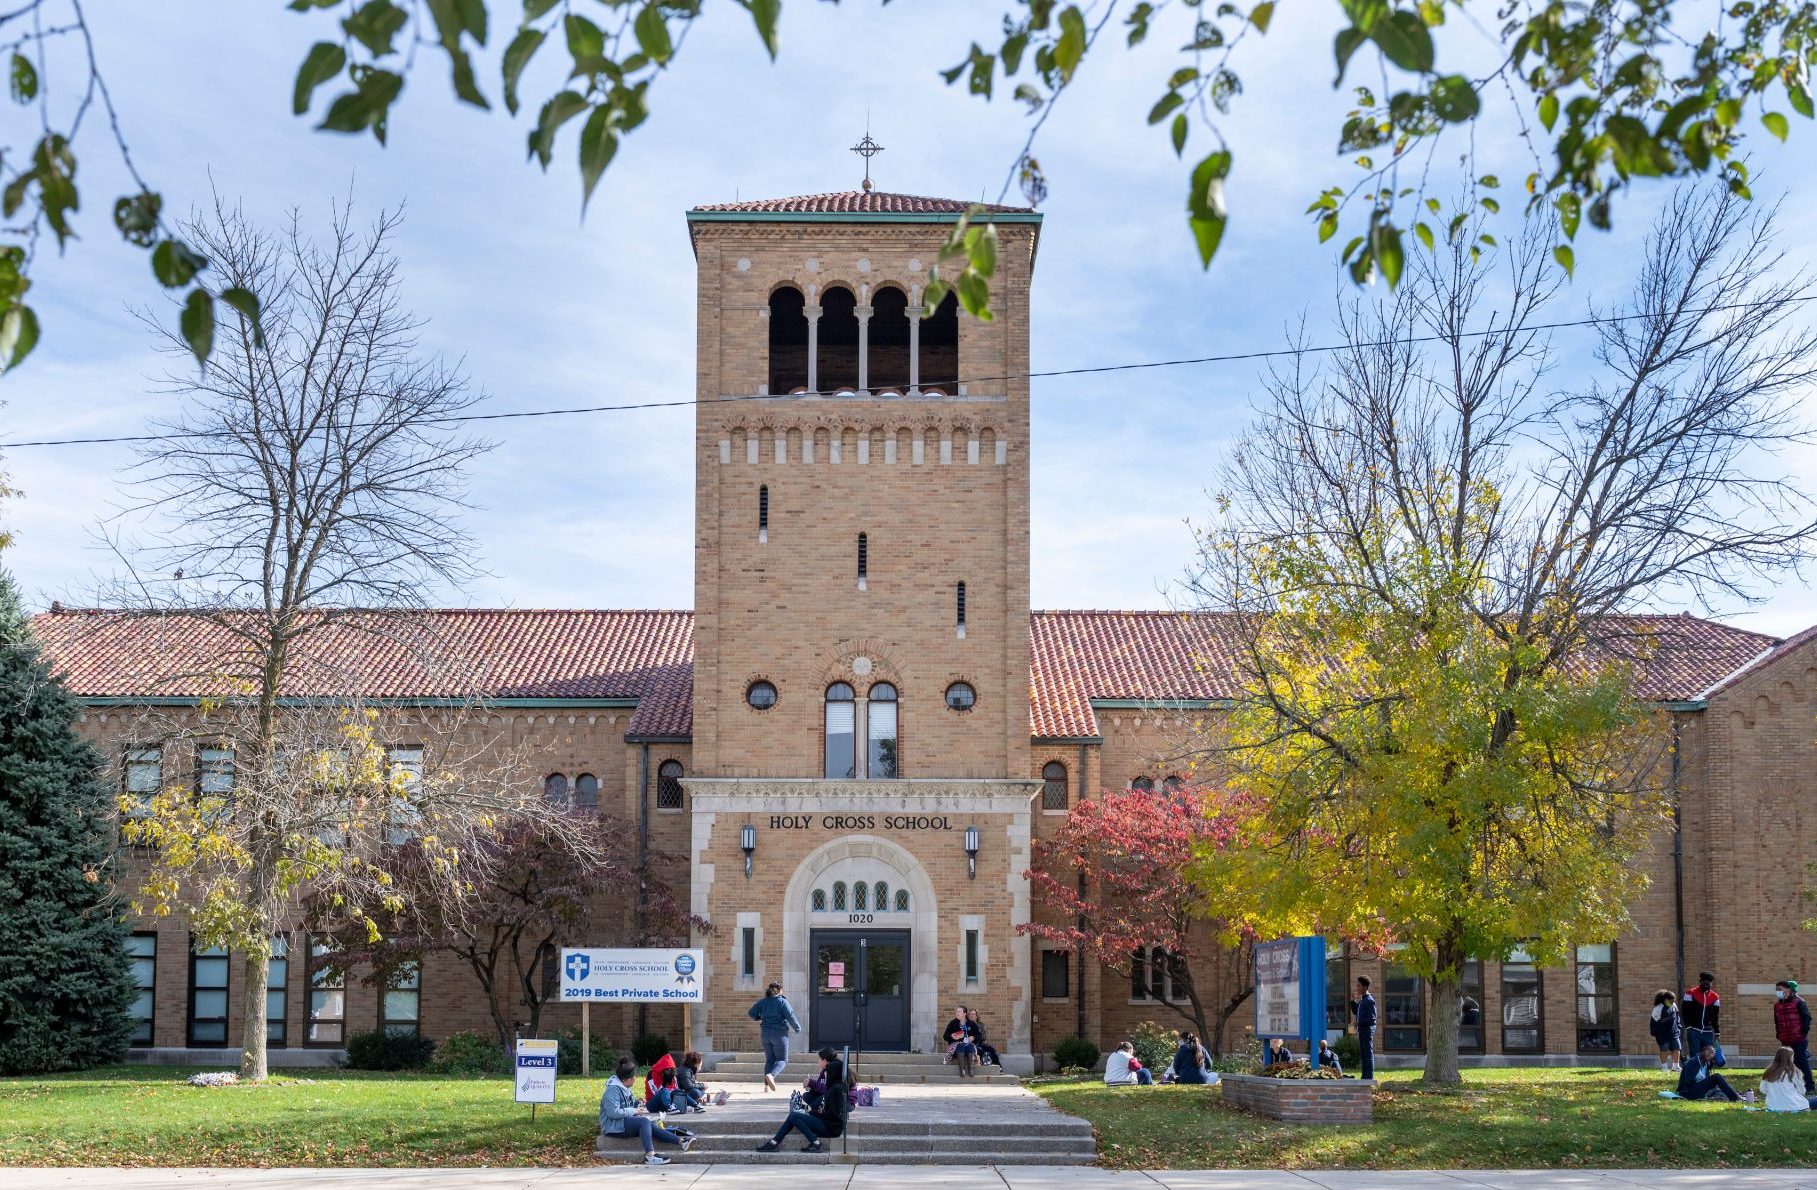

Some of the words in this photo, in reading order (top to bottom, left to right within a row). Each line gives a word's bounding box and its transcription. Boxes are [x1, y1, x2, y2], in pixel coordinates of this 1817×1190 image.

[769, 815, 813, 830] HOLY
[822, 816, 875, 830] CROSS
[884, 816, 953, 830] SCHOOL
[848, 913, 874, 924] 1020
[565, 988, 592, 997] 2019
[594, 988, 619, 998] Best
[621, 988, 660, 998] Private
[662, 989, 698, 998] School
[521, 1057, 545, 1066] Level
[546, 1058, 552, 1067] 3
